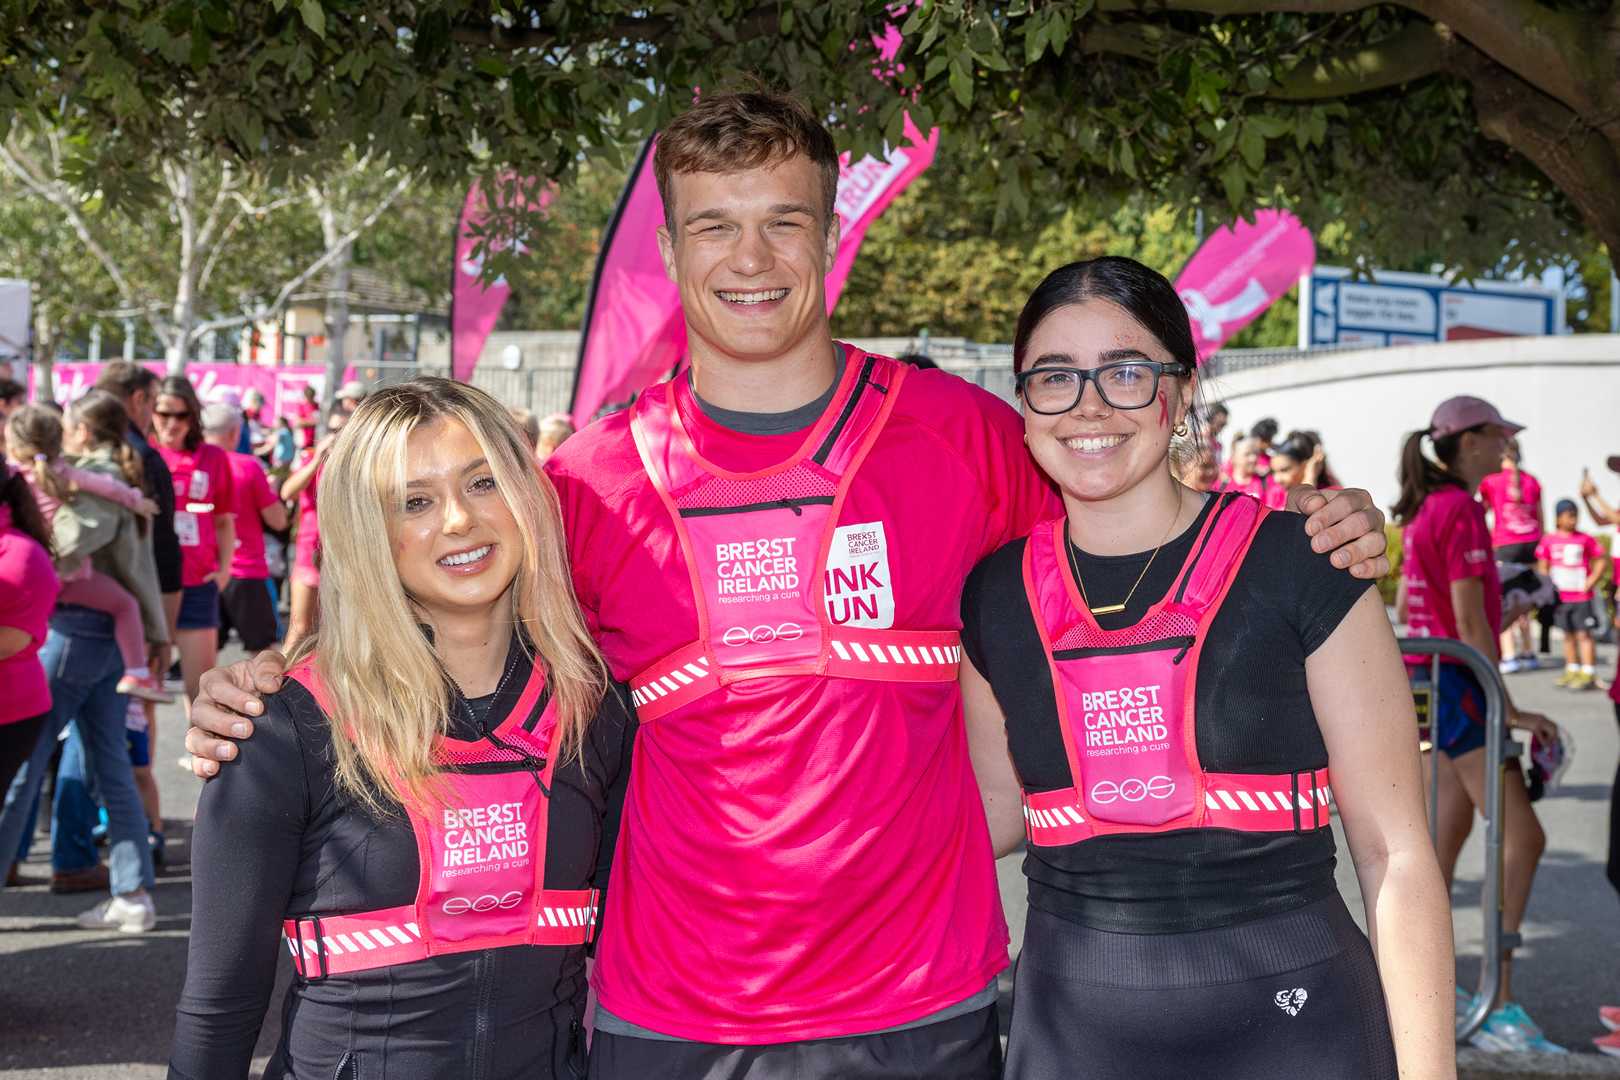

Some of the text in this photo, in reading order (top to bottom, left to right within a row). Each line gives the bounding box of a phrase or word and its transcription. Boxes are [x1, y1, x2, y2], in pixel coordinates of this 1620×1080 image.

[848, 538, 878, 548] CANCER
[849, 545, 880, 554] IRELAND
[717, 557, 798, 579] CANCER
[824, 561, 884, 597] INK
[718, 573, 799, 595] IRELAND
[718, 591, 771, 604] researching
[780, 590, 800, 600] cure
[828, 593, 879, 625] UN
[1084, 706, 1165, 730] CANCER
[1085, 724, 1168, 747] IRELAND
[1086, 745, 1139, 757] researching
[1149, 742, 1170, 751] cure
[444, 822, 527, 849] CANCER
[443, 840, 529, 867] IRELAND
[442, 862, 500, 878] researching
[512, 858, 530, 868] cure
